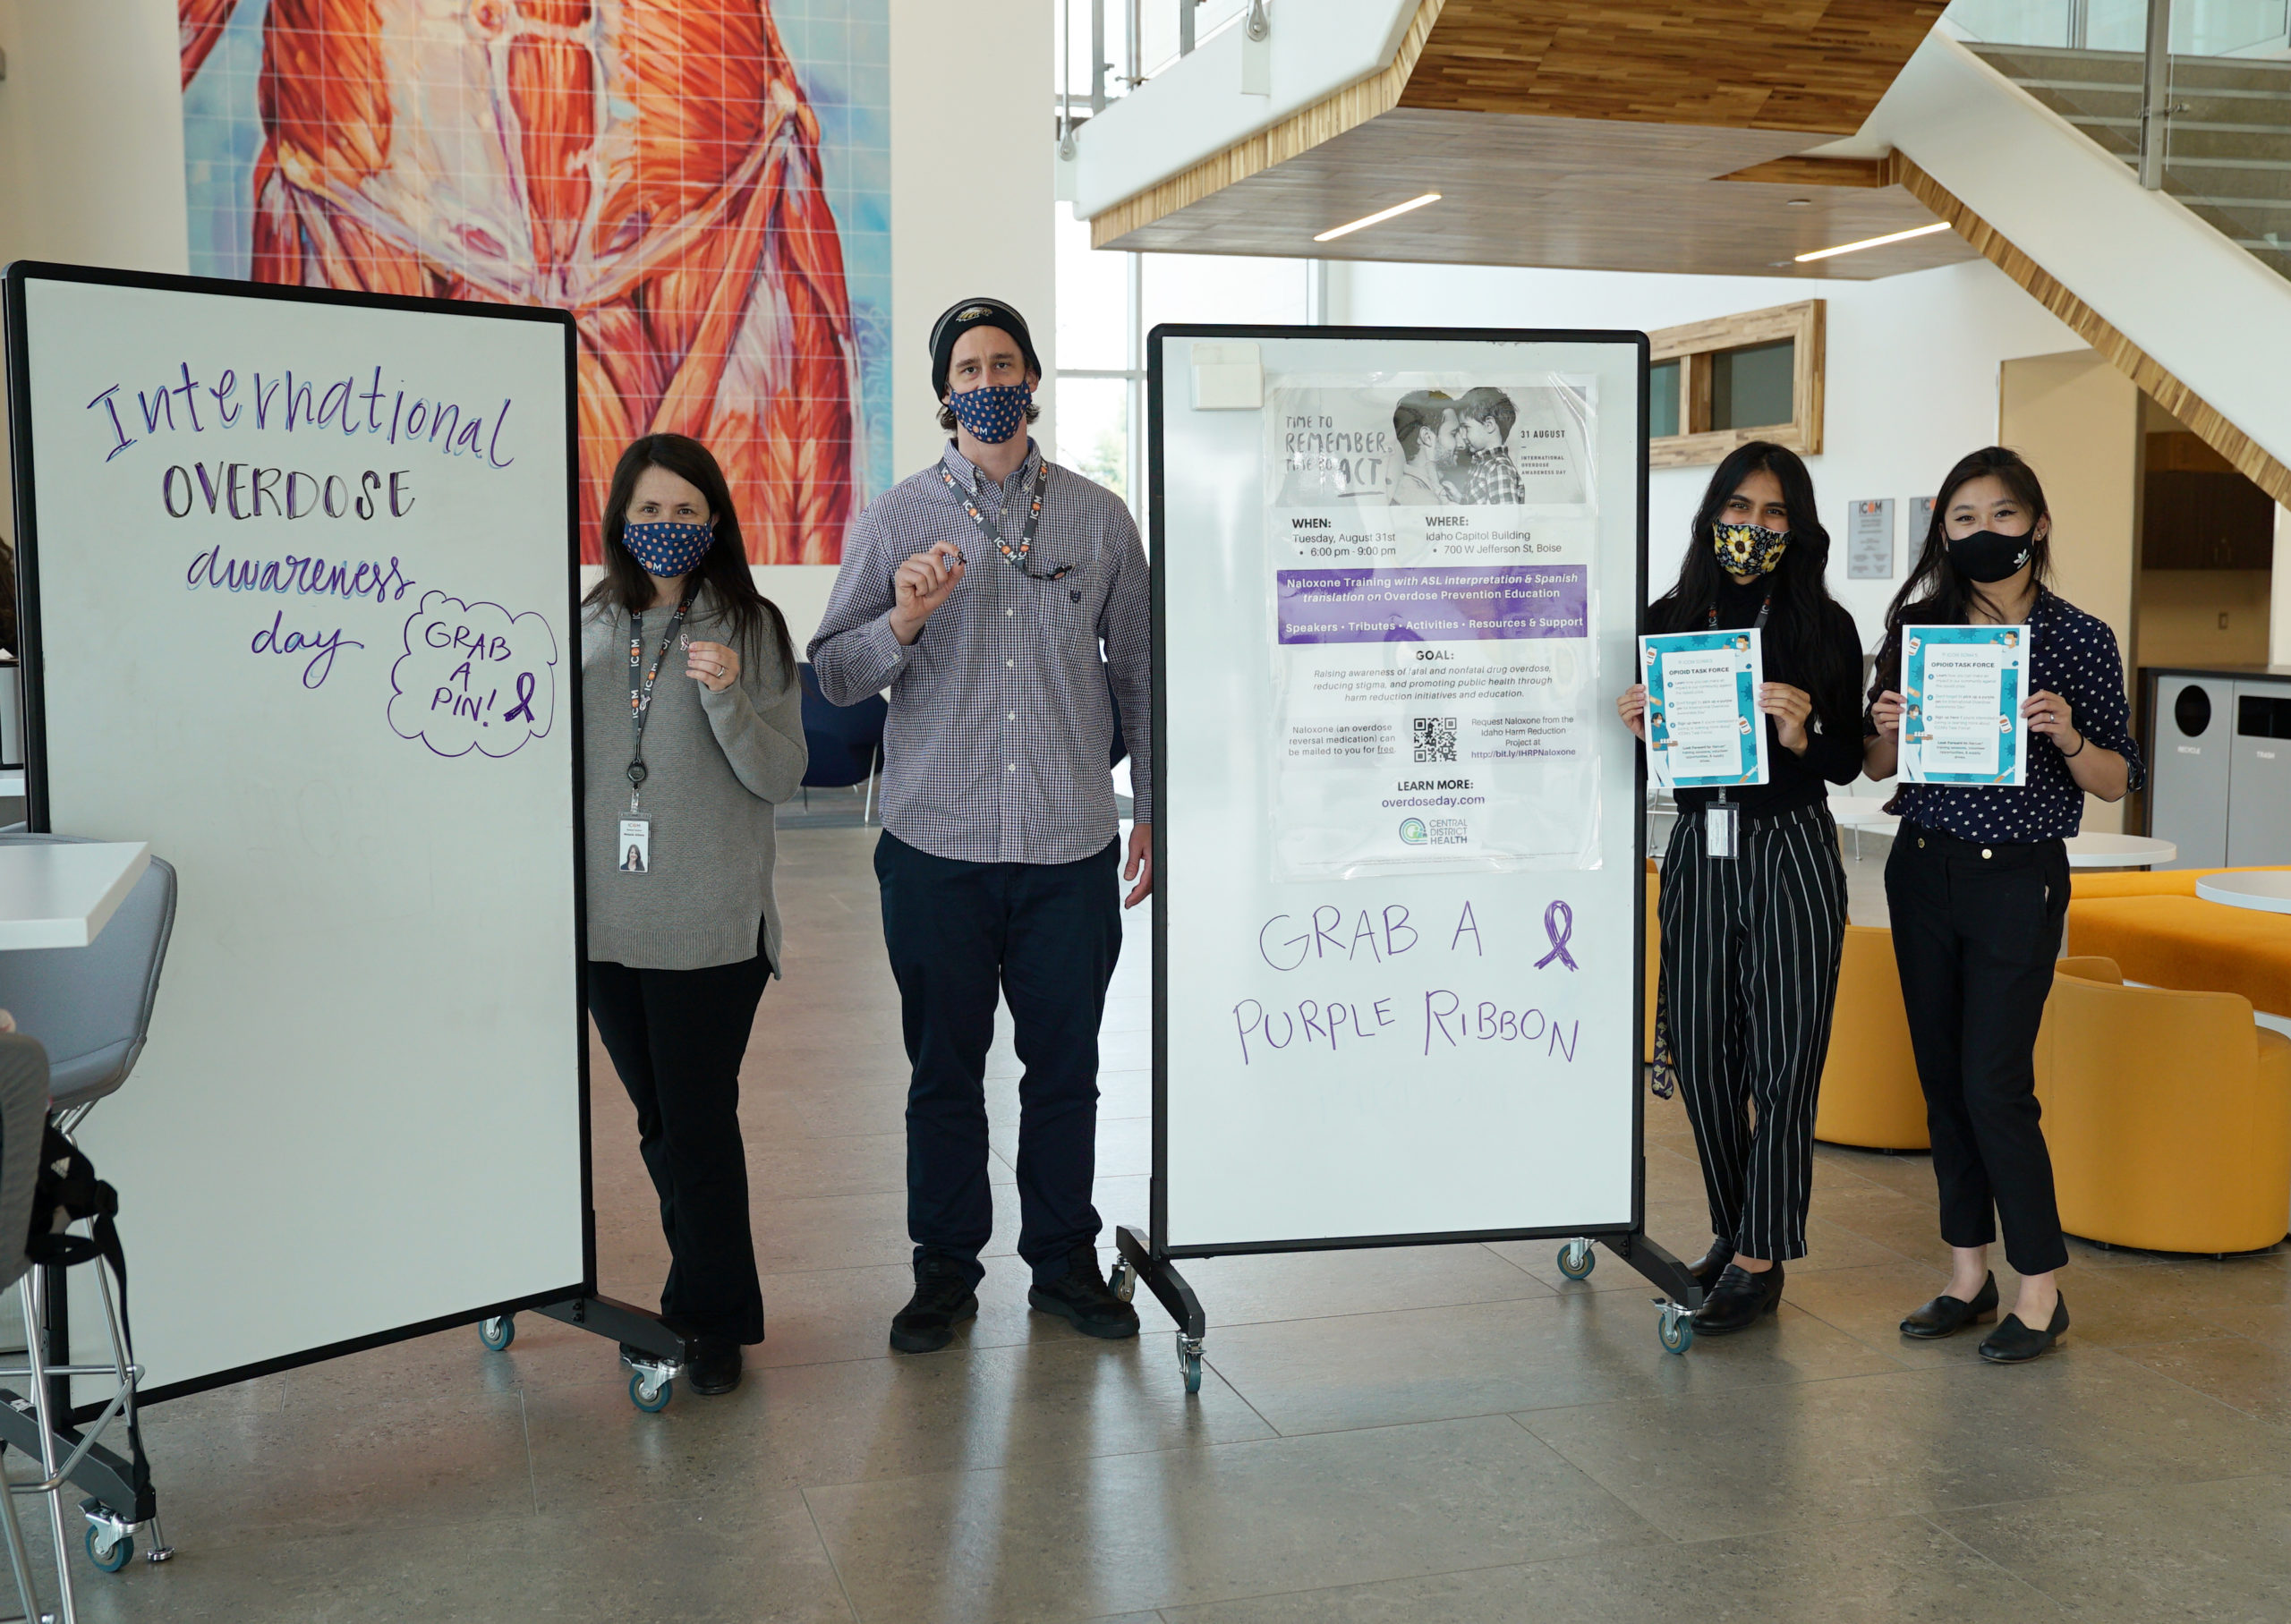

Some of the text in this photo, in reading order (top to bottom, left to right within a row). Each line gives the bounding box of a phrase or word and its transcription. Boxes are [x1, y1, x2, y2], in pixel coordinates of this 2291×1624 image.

[87, 361, 515, 469] International
[1286, 416, 1333, 429] TIME TO
[164, 461, 415, 520] OVERDOSE
[963, 499, 984, 523] ICOM
[1030, 496, 1043, 519] ICOM
[1859, 501, 1882, 514] ICOM
[1292, 518, 1332, 528] WHEN:
[1426, 516, 1469, 526] WHERE:
[1293, 533, 1396, 544] Tuesday, August 31st
[1426, 531, 1530, 542] Idaho Capitol Building
[994, 537, 1017, 561] ICOM
[1018, 537, 1032, 560] ICOM
[1310, 548, 1332, 557] 6:00
[1334, 549, 1350, 557] pm
[1358, 547, 1378, 555] 9:00
[1381, 548, 1396, 557] pm
[1444, 544, 1562, 554] 700 W Jefferson St, Boise
[186, 545, 416, 603] awareness
[1287, 574, 1578, 589] Naloxone Training with ASL interpretation & Spanish
[1304, 593, 1364, 603] translation
[1384, 591, 1437, 601] Overdose
[1441, 590, 1501, 599] Prevention
[1505, 589, 1560, 598] Education
[1286, 617, 1583, 633] Speakers Tributes Activities Resources & Support
[423, 622, 512, 661] GRAB
[251, 610, 364, 689] day
[631, 639, 640, 667] ICOM
[1416, 650, 1454, 660] GOAL:
[449, 662, 472, 690] A
[644, 663, 658, 691] ICOM
[1314, 670, 1346, 678] Raising
[1349, 668, 1394, 676] awareness
[1448, 666, 1485, 674] nonfatal
[1486, 666, 1507, 674] drug
[1314, 682, 1353, 691] reducing
[1409, 679, 1455, 688] promoting
[1458, 678, 1486, 687] public
[1488, 677, 1515, 685] health
[1518, 676, 1553, 685] through
[1415, 692, 1456, 700] initiatives
[1478, 690, 1524, 698] education.
[431, 689, 497, 727] PIN!
[631, 689, 639, 718] ICOM
[1292, 726, 1333, 734] Naloxone
[1352, 724, 1392, 732] overdose
[1472, 718, 1503, 727] Request
[1326, 735, 1377, 744] medication)
[1505, 739, 1531, 747] Project
[1302, 747, 1331, 755] mailed
[1471, 749, 1576, 759] http://bit.ly/IHRPNaloxone
[1398, 779, 1473, 791] LEARN MORE:
[1382, 795, 1485, 808] overdoseday.com
[1429, 820, 1468, 828] CENTRAL
[1430, 828, 1468, 836] DISTRICT
[1430, 837, 1467, 845] HEALTH
[1259, 900, 1482, 972] GRAB A
[1233, 989, 1580, 1065] PURPLE RIBBON
